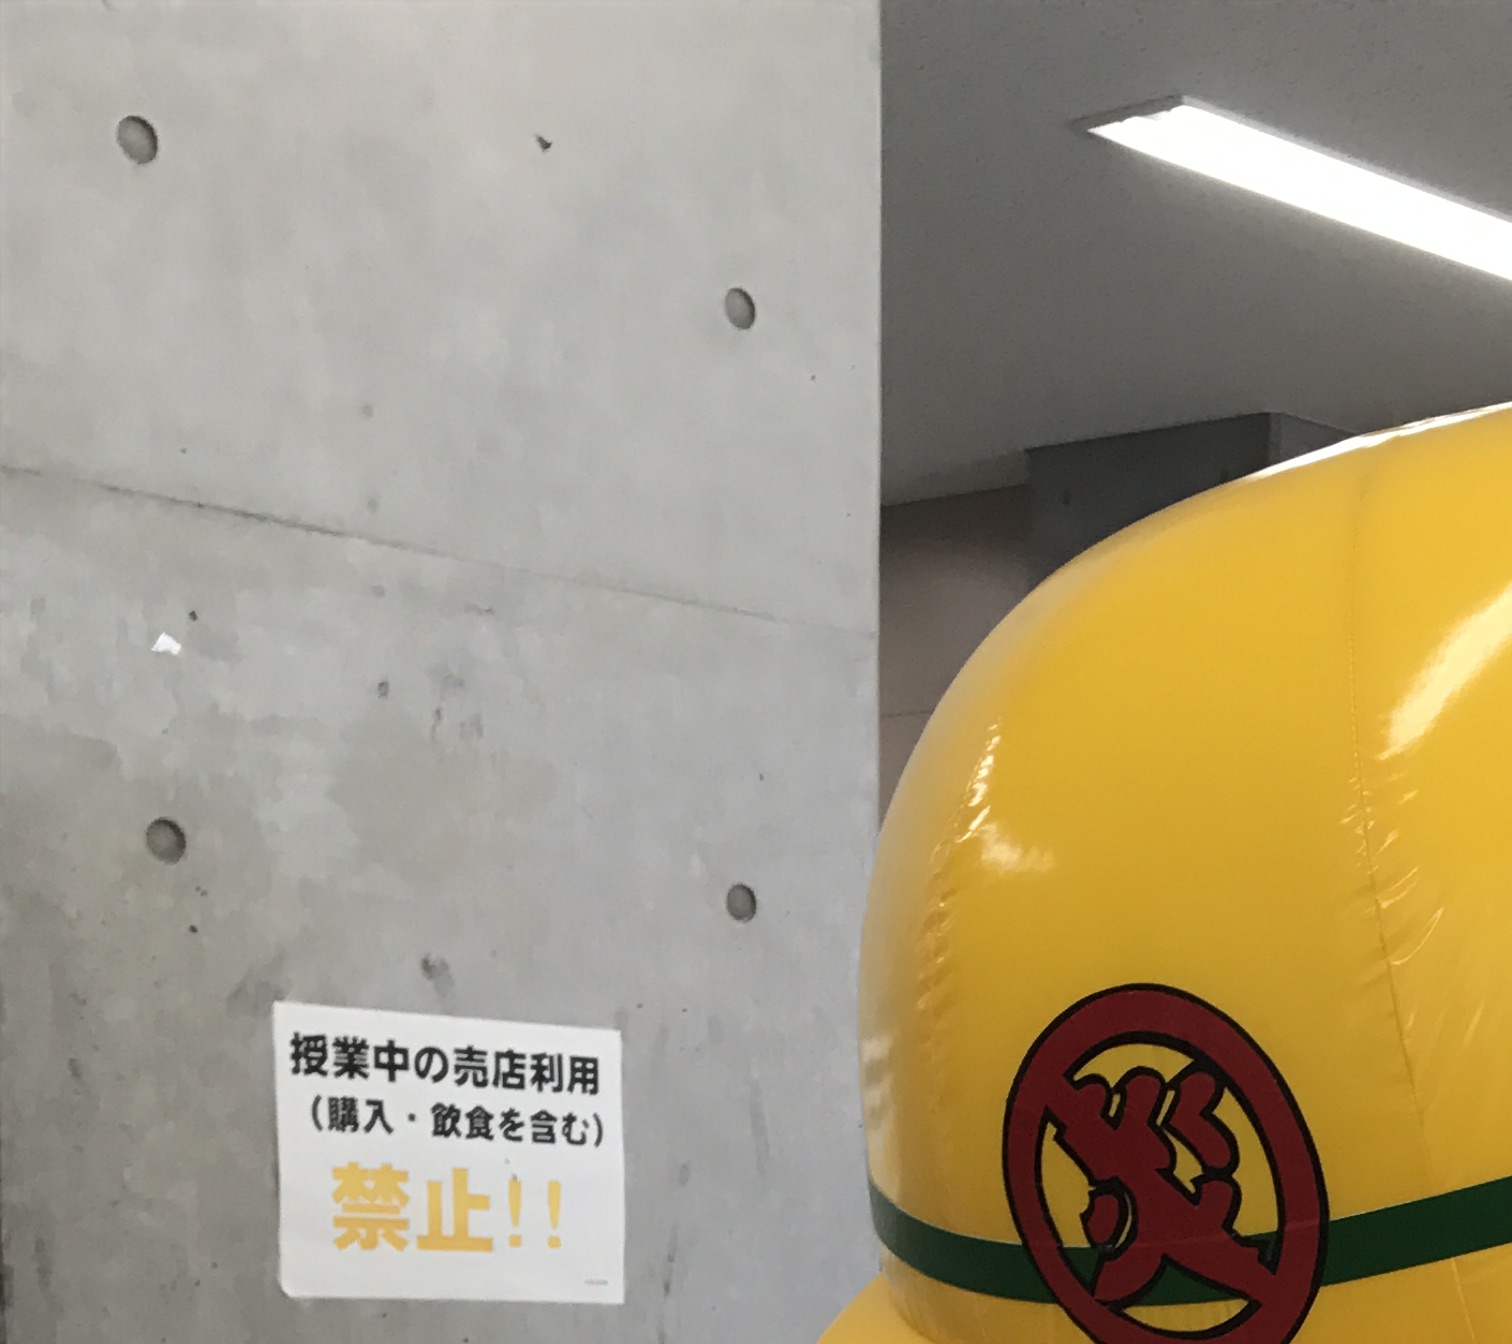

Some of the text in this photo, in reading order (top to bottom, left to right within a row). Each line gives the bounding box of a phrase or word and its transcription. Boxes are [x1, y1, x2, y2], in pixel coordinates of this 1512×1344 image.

[290, 1031, 599, 1095] 授業中の売店利用
